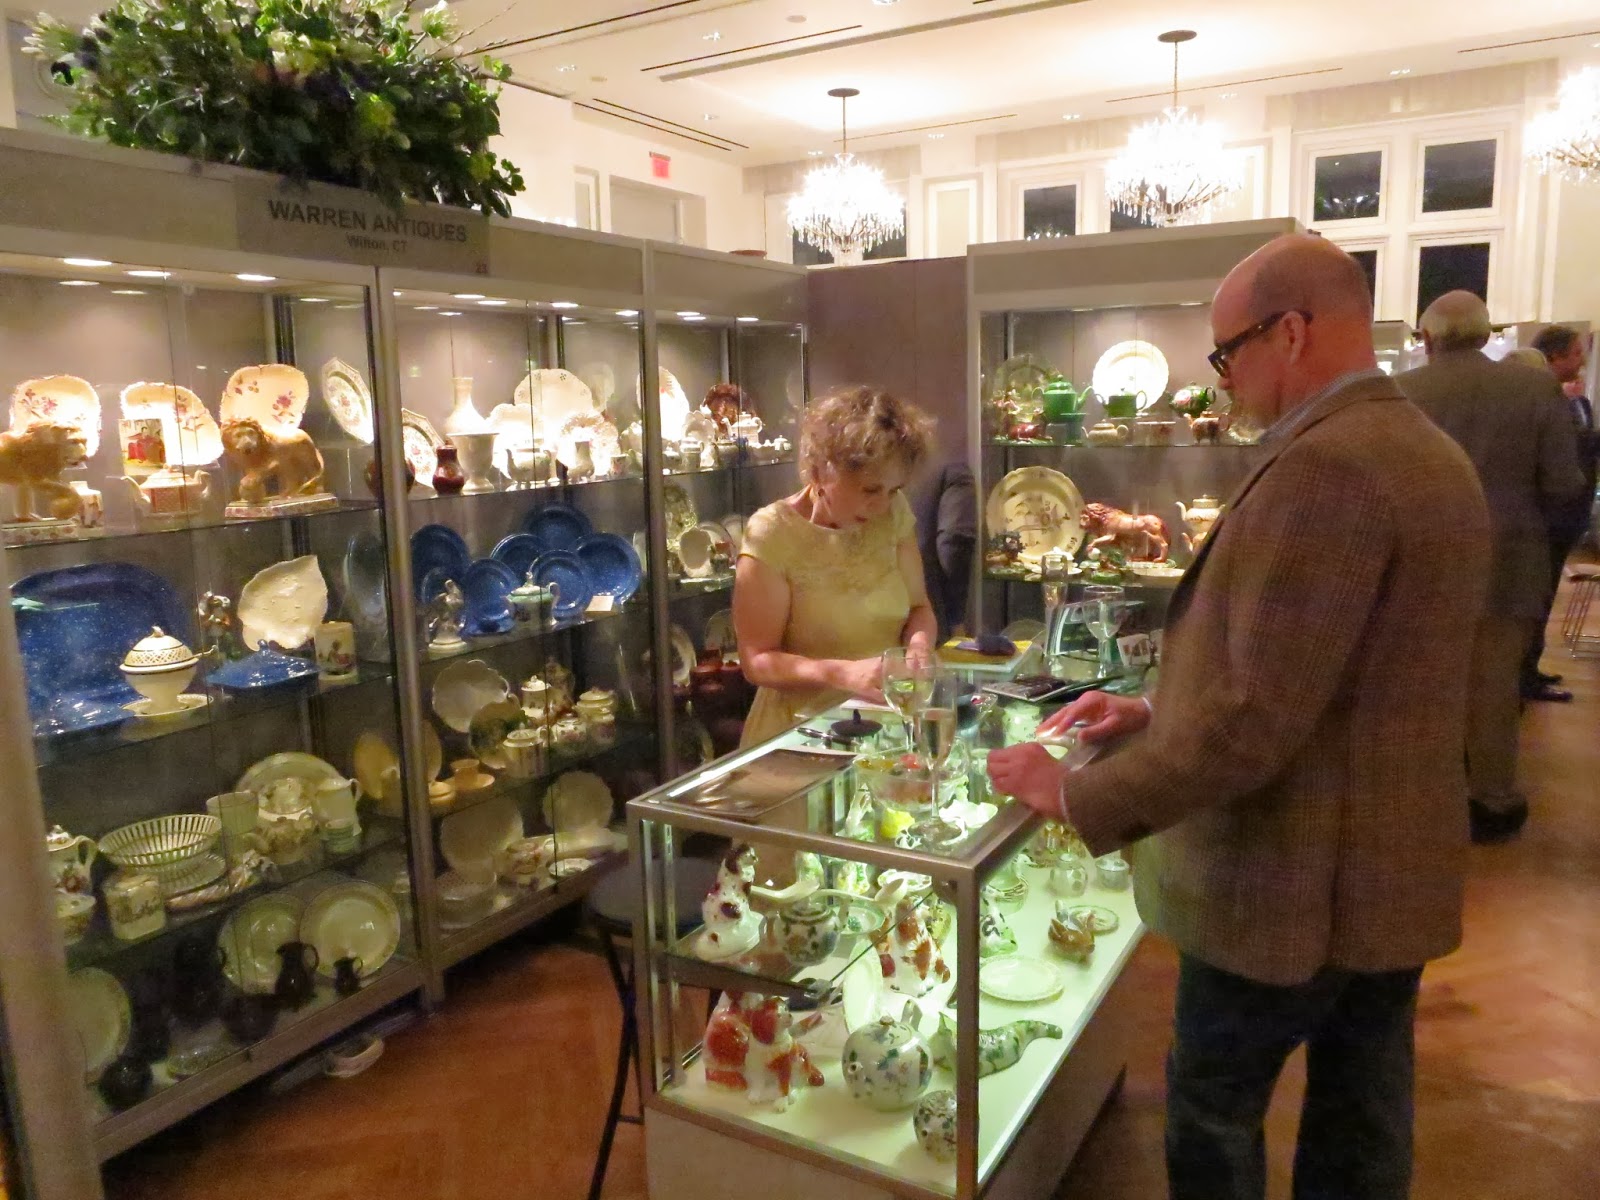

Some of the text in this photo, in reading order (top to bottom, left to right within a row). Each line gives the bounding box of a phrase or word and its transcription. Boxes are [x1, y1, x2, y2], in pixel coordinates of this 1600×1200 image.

[268, 200, 466, 242] WARREN ANTIQUES
[393, 240, 407, 252] CT
